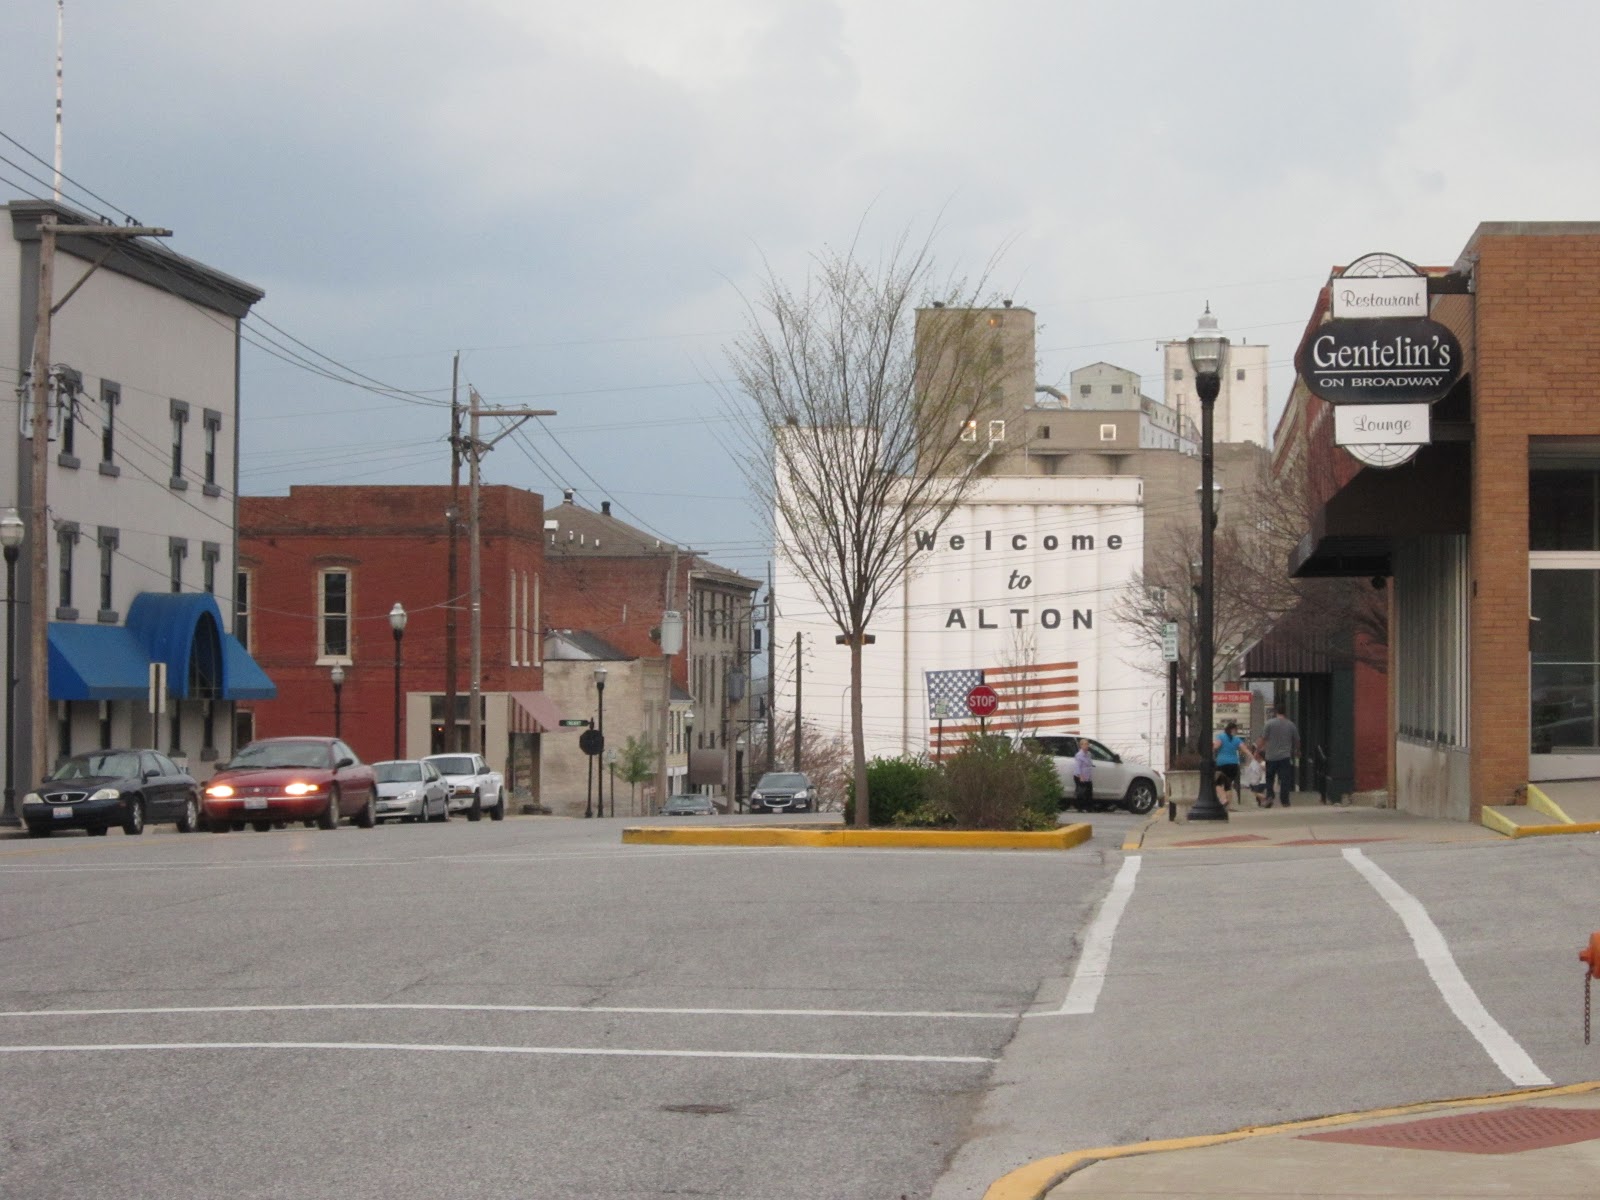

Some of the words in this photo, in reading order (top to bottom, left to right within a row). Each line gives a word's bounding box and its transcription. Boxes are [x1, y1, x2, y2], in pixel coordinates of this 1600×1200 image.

[1341, 289, 1421, 308] Restaurant
[1313, 335, 1452, 368] Gentelin's
[1319, 377, 1345, 388] ON
[1351, 376, 1443, 387] BROADWAY
[1353, 414, 1412, 435] Lounge
[914, 530, 1123, 551] Welcome
[1007, 569, 1032, 590] to
[945, 608, 1094, 630] ALTON
[969, 695, 996, 707] STOP
